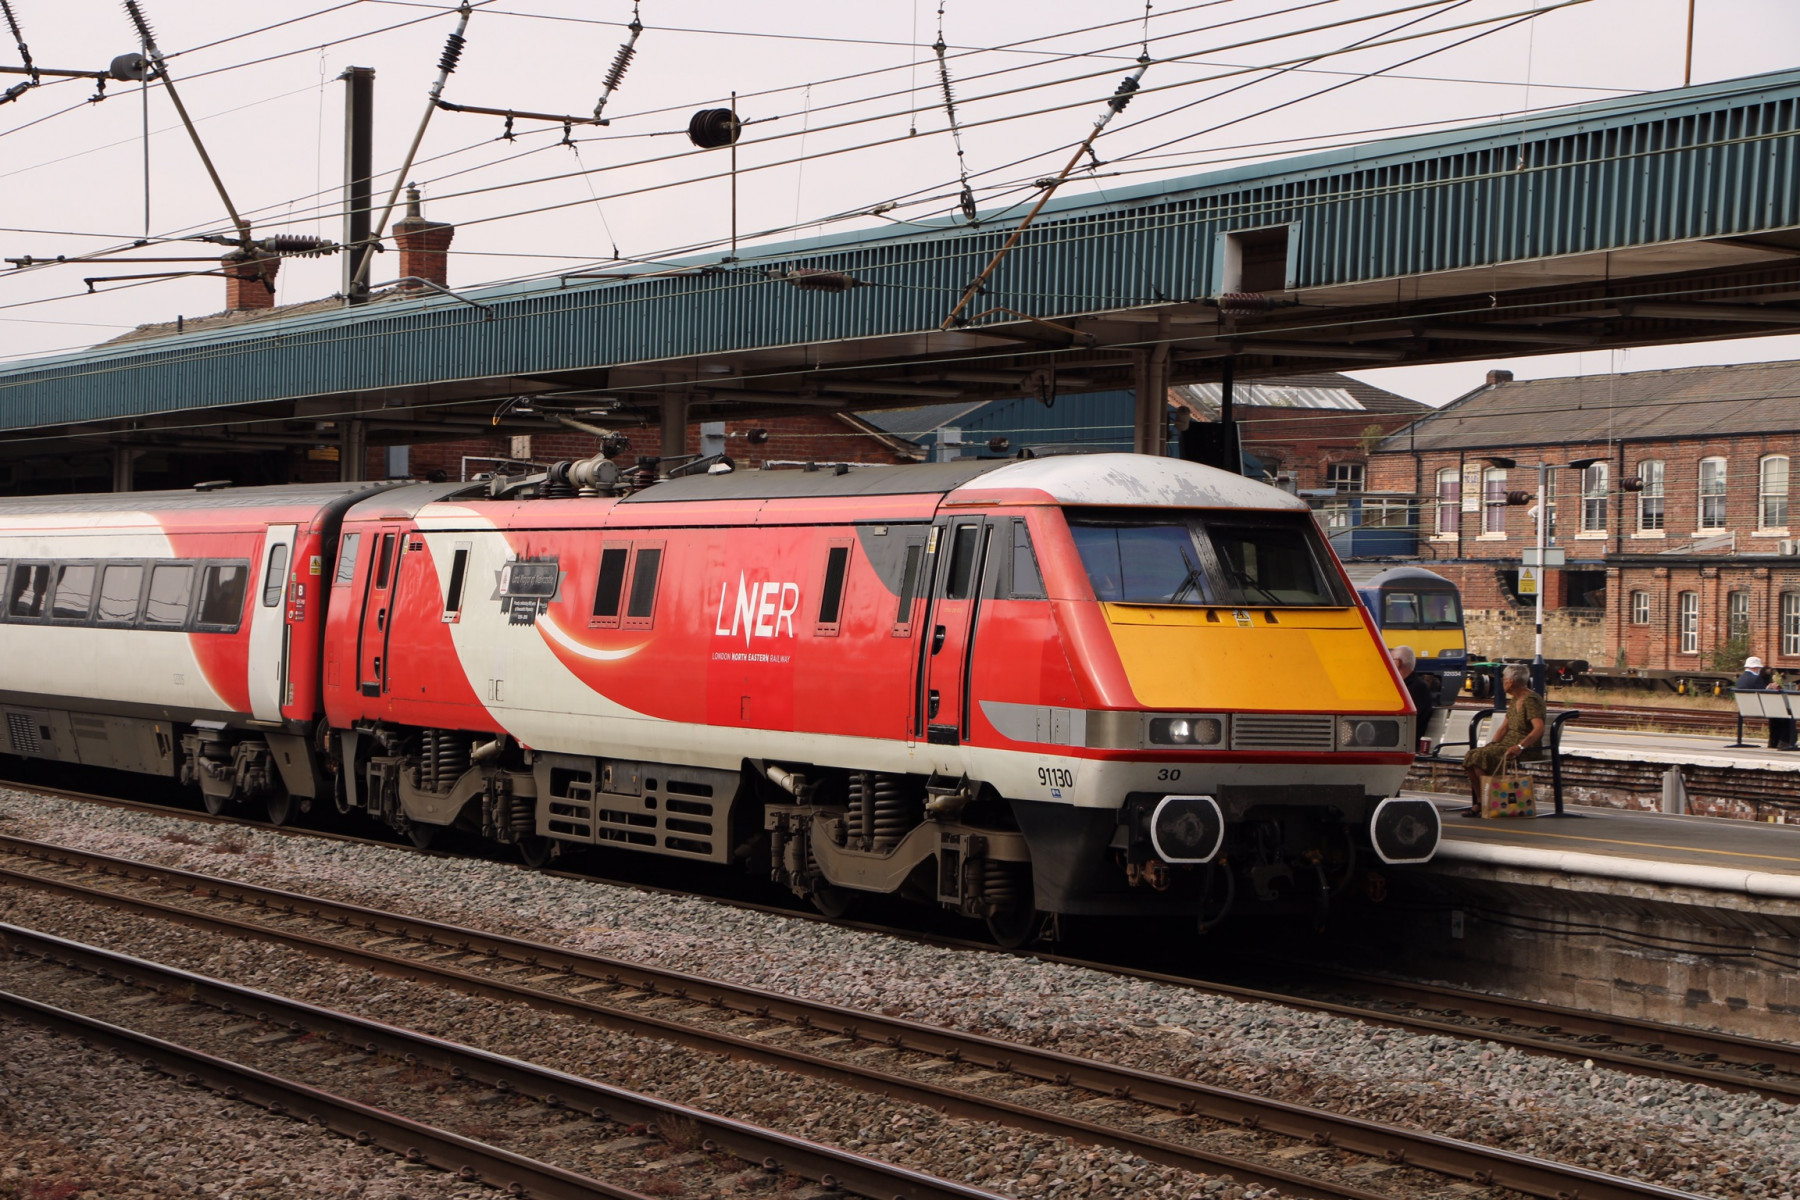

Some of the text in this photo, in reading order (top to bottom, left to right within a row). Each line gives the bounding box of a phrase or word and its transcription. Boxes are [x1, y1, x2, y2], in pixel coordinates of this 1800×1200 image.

[298, 585, 304, 596] B
[715, 568, 800, 649] LNER
[712, 652, 790, 663] LONDON NORTH EASTERN RAILWAY
[1038, 767, 1073, 788] 91130
[1157, 768, 1181, 782] 30
